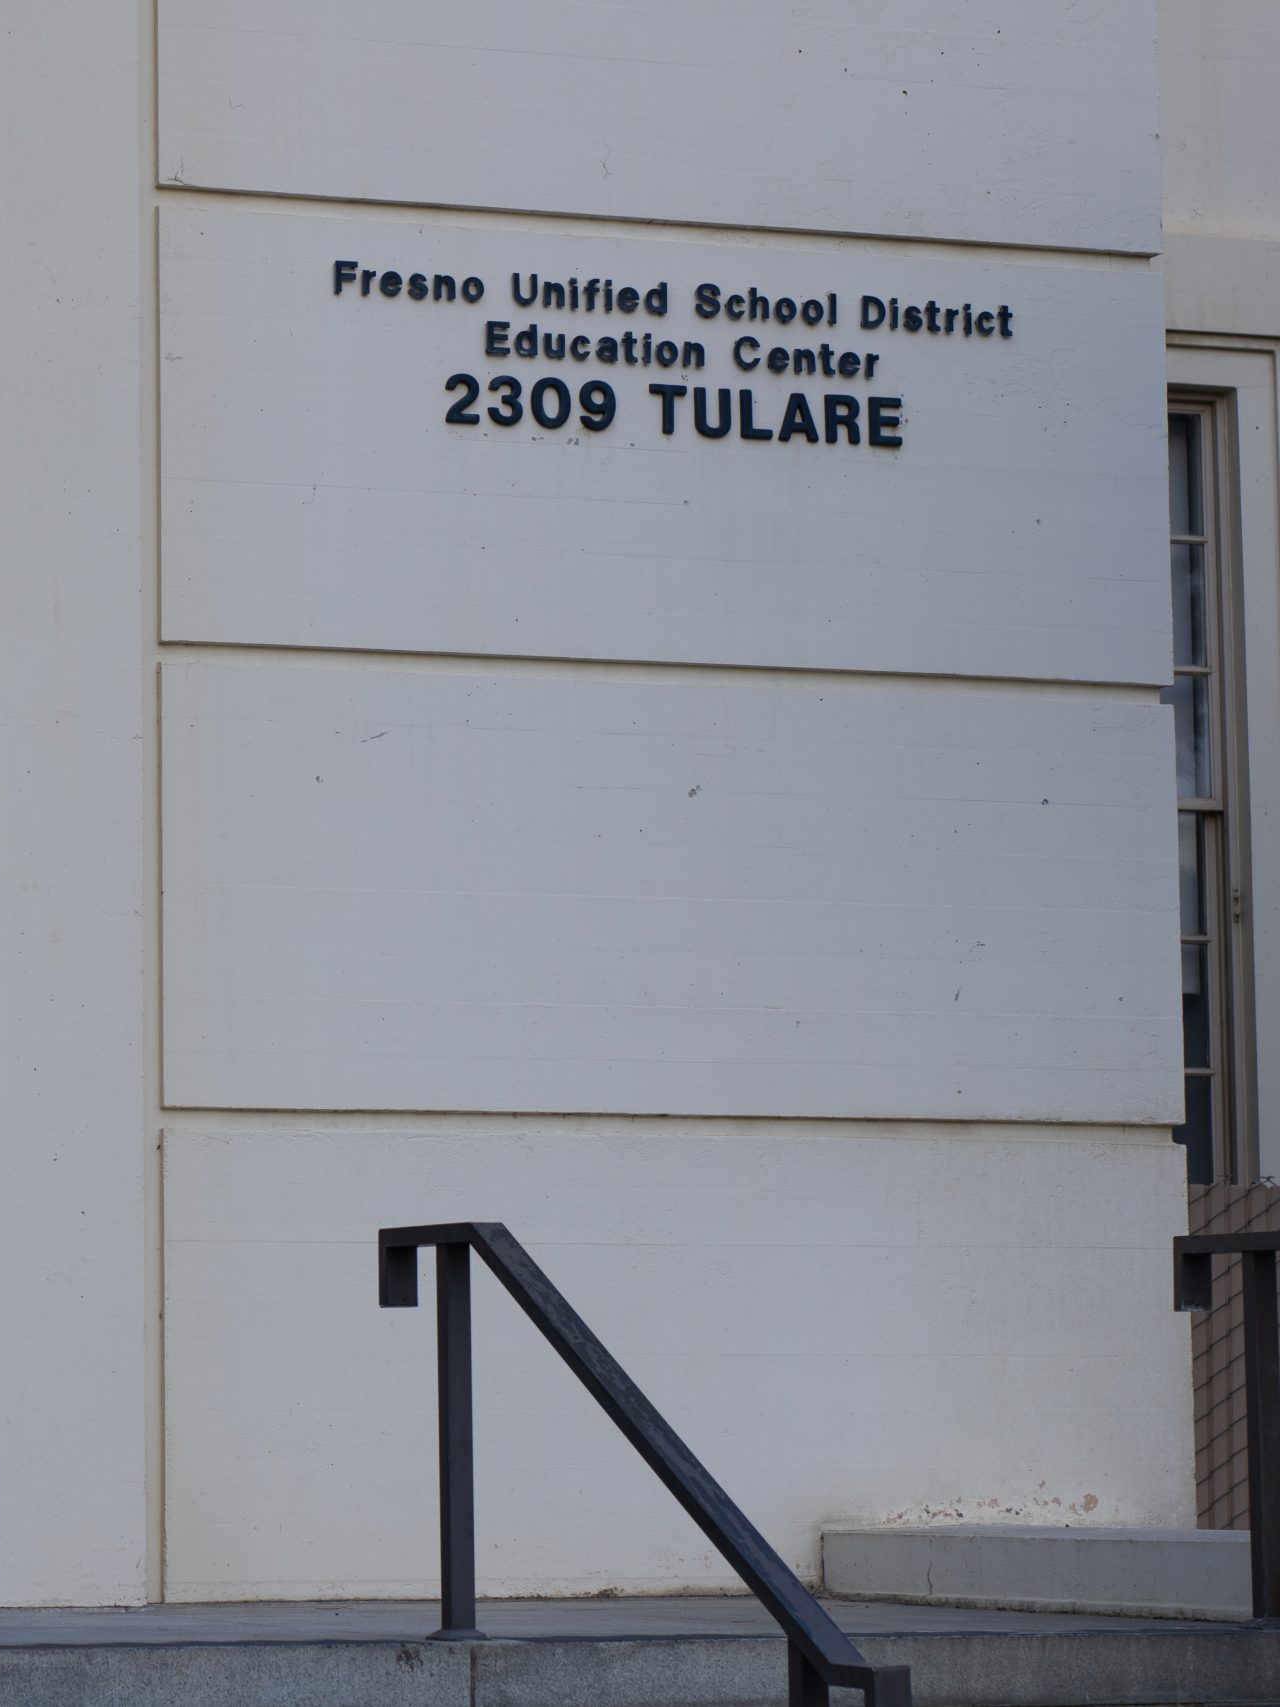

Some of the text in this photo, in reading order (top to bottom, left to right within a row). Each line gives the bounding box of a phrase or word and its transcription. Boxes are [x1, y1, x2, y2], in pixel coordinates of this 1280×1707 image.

[333, 260, 1014, 341] Fresno Unified School District
[485, 320, 880, 381] Education Center
[445, 373, 904, 451] 2309 TULARE
